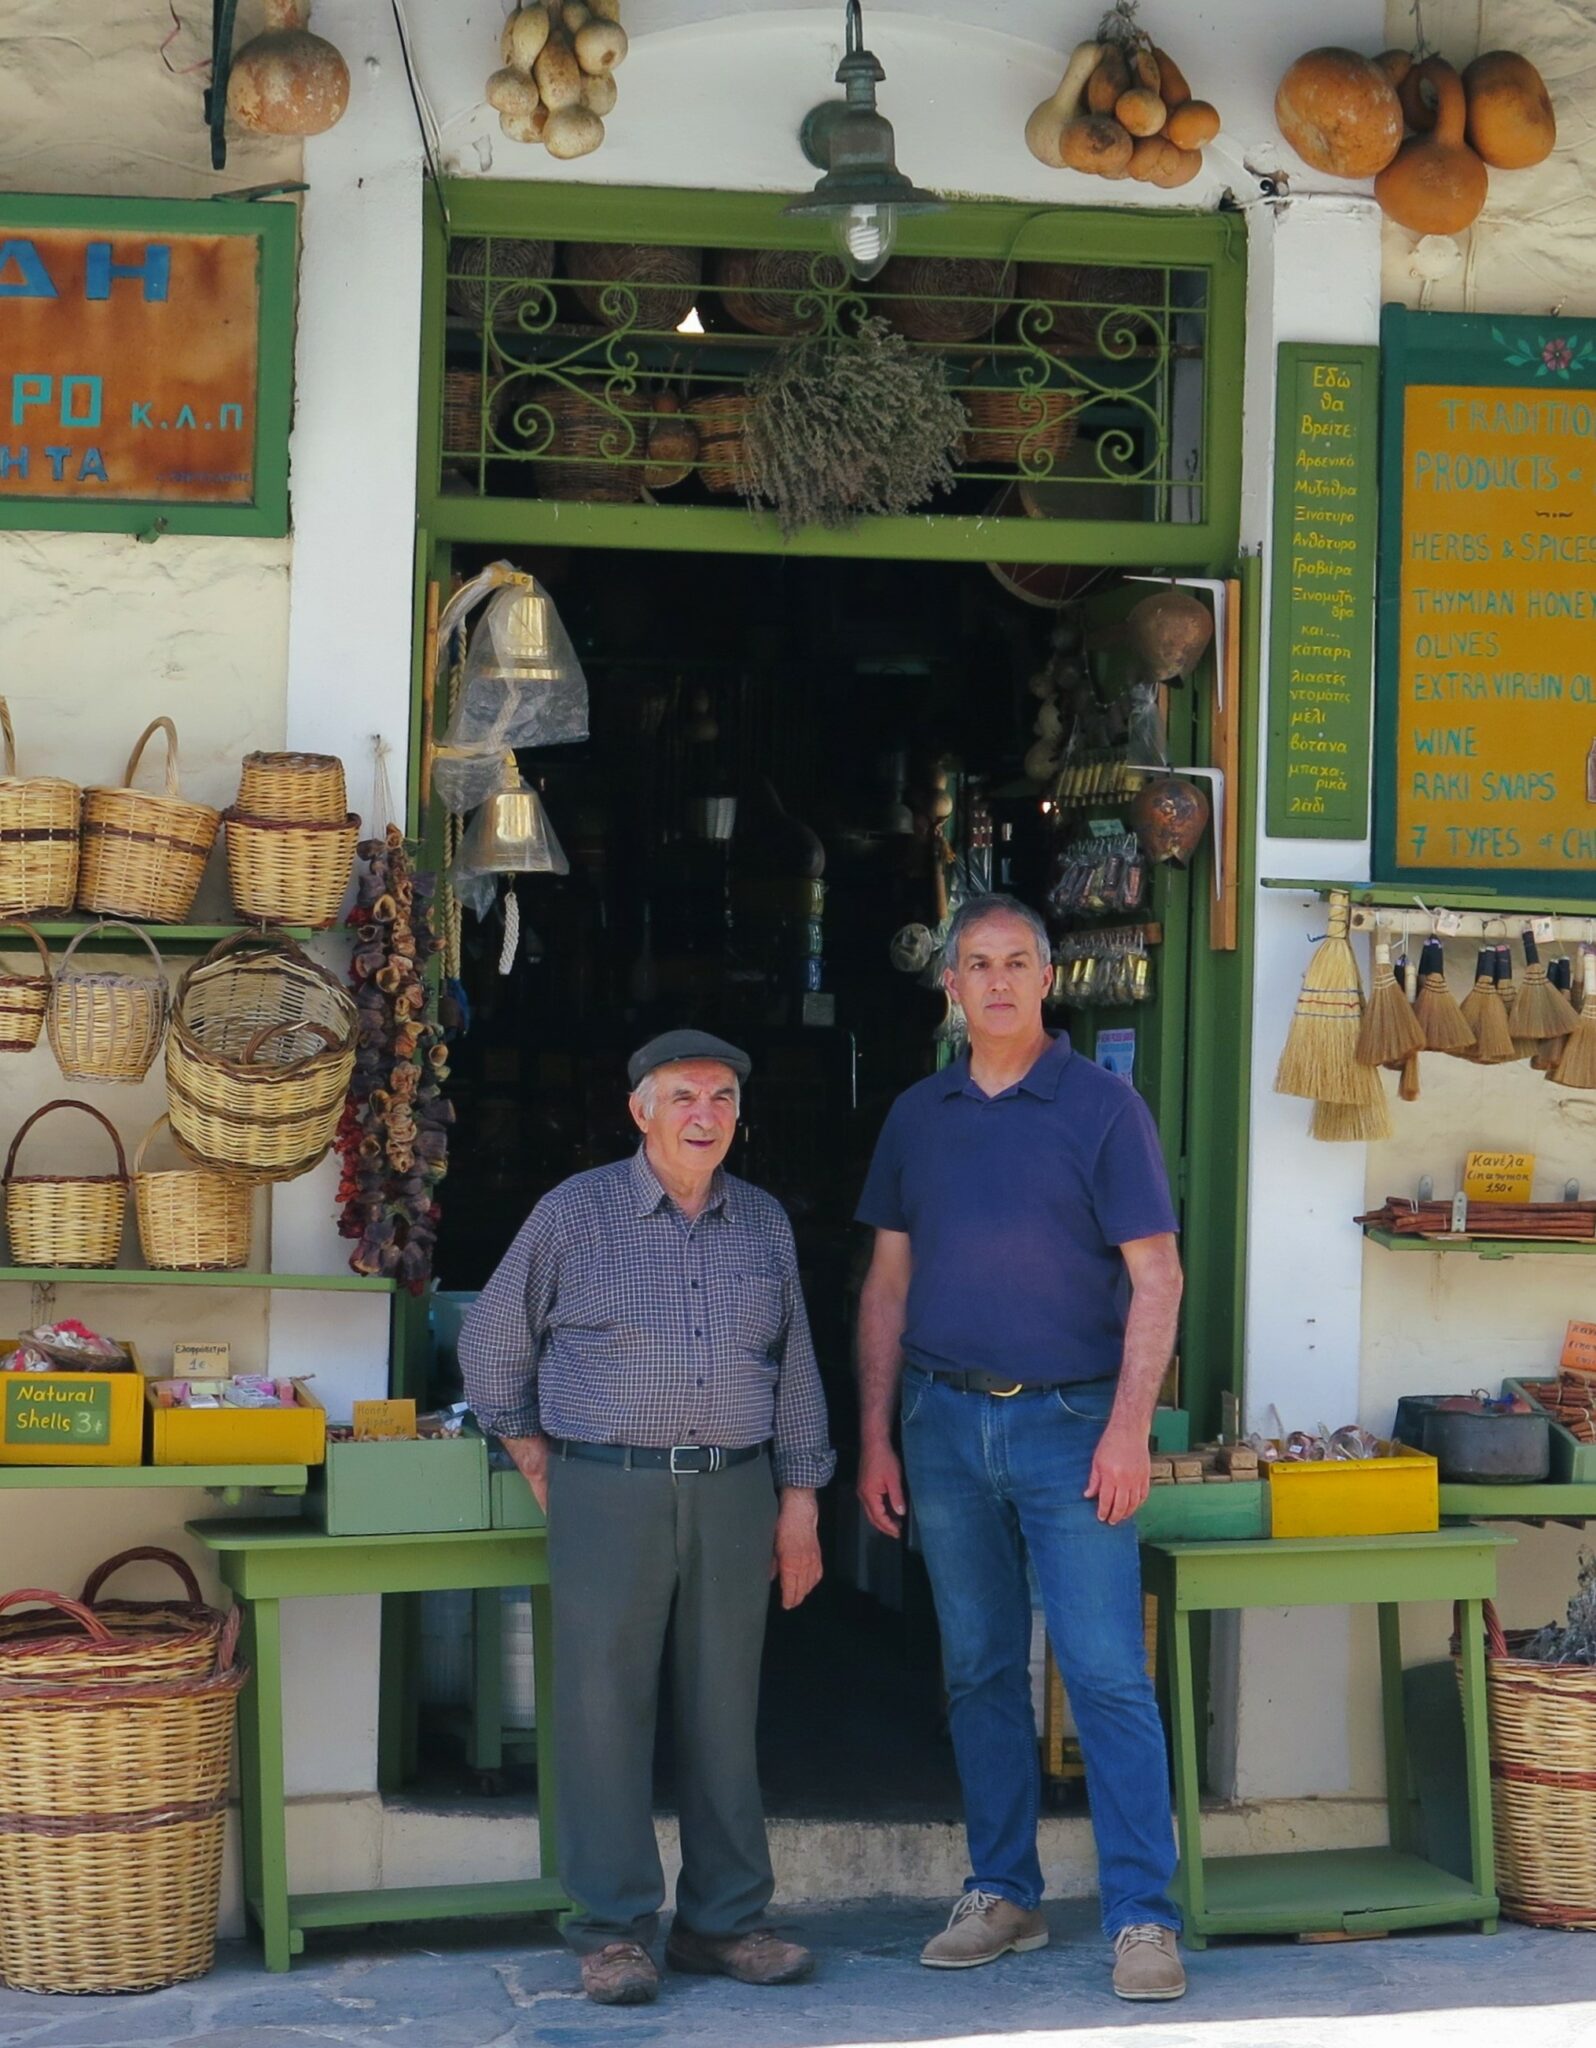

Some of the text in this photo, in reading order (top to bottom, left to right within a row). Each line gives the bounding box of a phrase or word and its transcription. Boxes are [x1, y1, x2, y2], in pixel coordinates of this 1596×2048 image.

[1312, 366, 1351, 388] Εδώ
[12, 374, 103, 428] ΡΟ
[1320, 391, 1345, 412] θα
[1441, 398, 1596, 438] TRADITIO
[1414, 450, 1559, 491] PRODUCTS
[1294, 479, 1358, 499] Μυζήθρα
[1411, 531, 1493, 562] HERBS
[1411, 588, 1515, 615] THYMIAN
[1415, 631, 1500, 659] OLIVES
[1415, 672, 1488, 701] EXTRA
[1493, 672, 1563, 700] VIRGIN
[1291, 707, 1326, 727] μέλι
[1413, 726, 1479, 757] WINE
[1412, 771, 1557, 802] RAKI SNAPS
[1290, 796, 1325, 813] λάδι
[1411, 824, 1428, 859] 7
[1446, 826, 1522, 858] TYPES
[1562, 826, 1596, 860] CH
[16, 1385, 95, 1404] Natural
[16, 1408, 72, 1432] Shells
